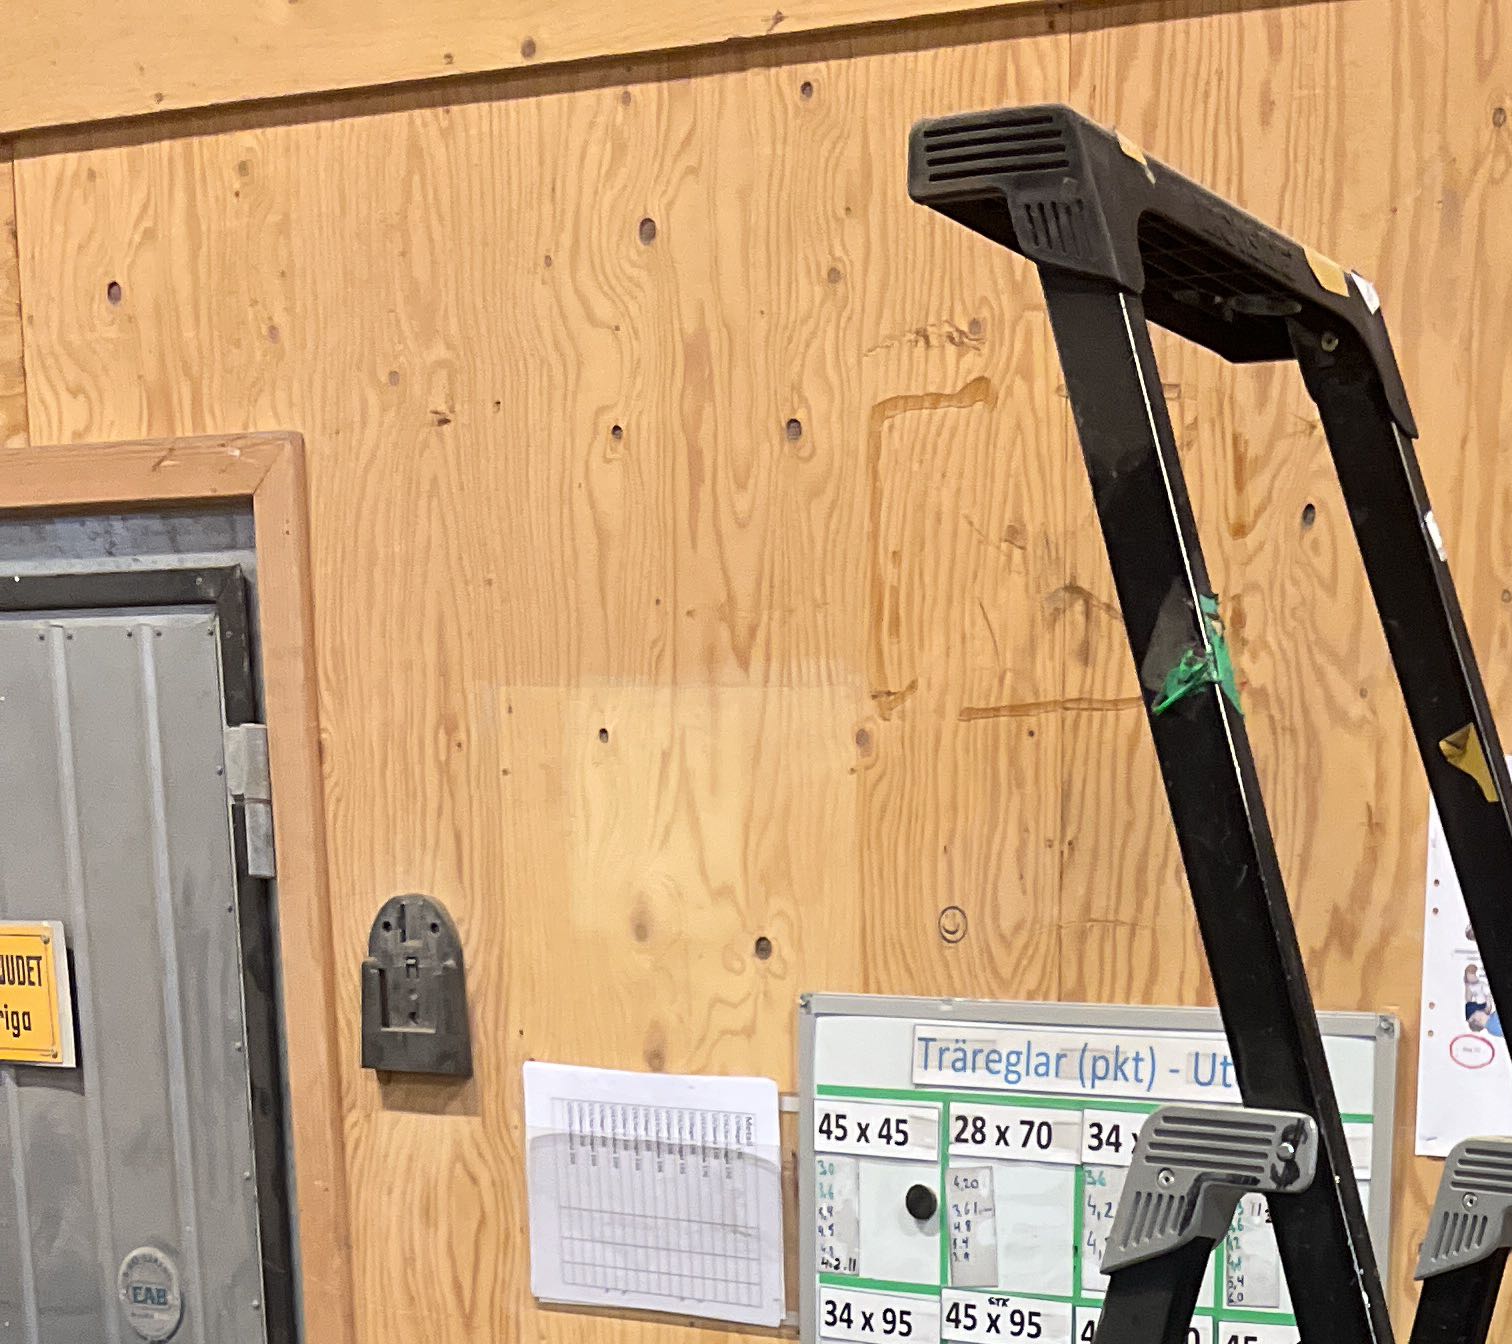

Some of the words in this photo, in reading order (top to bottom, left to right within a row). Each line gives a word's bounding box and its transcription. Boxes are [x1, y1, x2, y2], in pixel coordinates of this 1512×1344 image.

[918, 1037, 1067, 1084] Träreglar
[1079, 1043, 1156, 1091] (pkt)
[818, 1114, 848, 1142] 45
[857, 1123, 870, 1144] x
[878, 1118, 909, 1147] 45
[954, 1116, 986, 1144] 28
[995, 1124, 1009, 1147] x
[1020, 1121, 1053, 1150] 70
[1087, 1123, 1122, 1153] 34
[824, 1299, 853, 1328] 34
[861, 1311, 874, 1333] x
[882, 1308, 913, 1337] 95
[945, 1302, 977, 1331] 45
[986, 1312, 1001, 1335] x
[1009, 1309, 1042, 1339] 95
